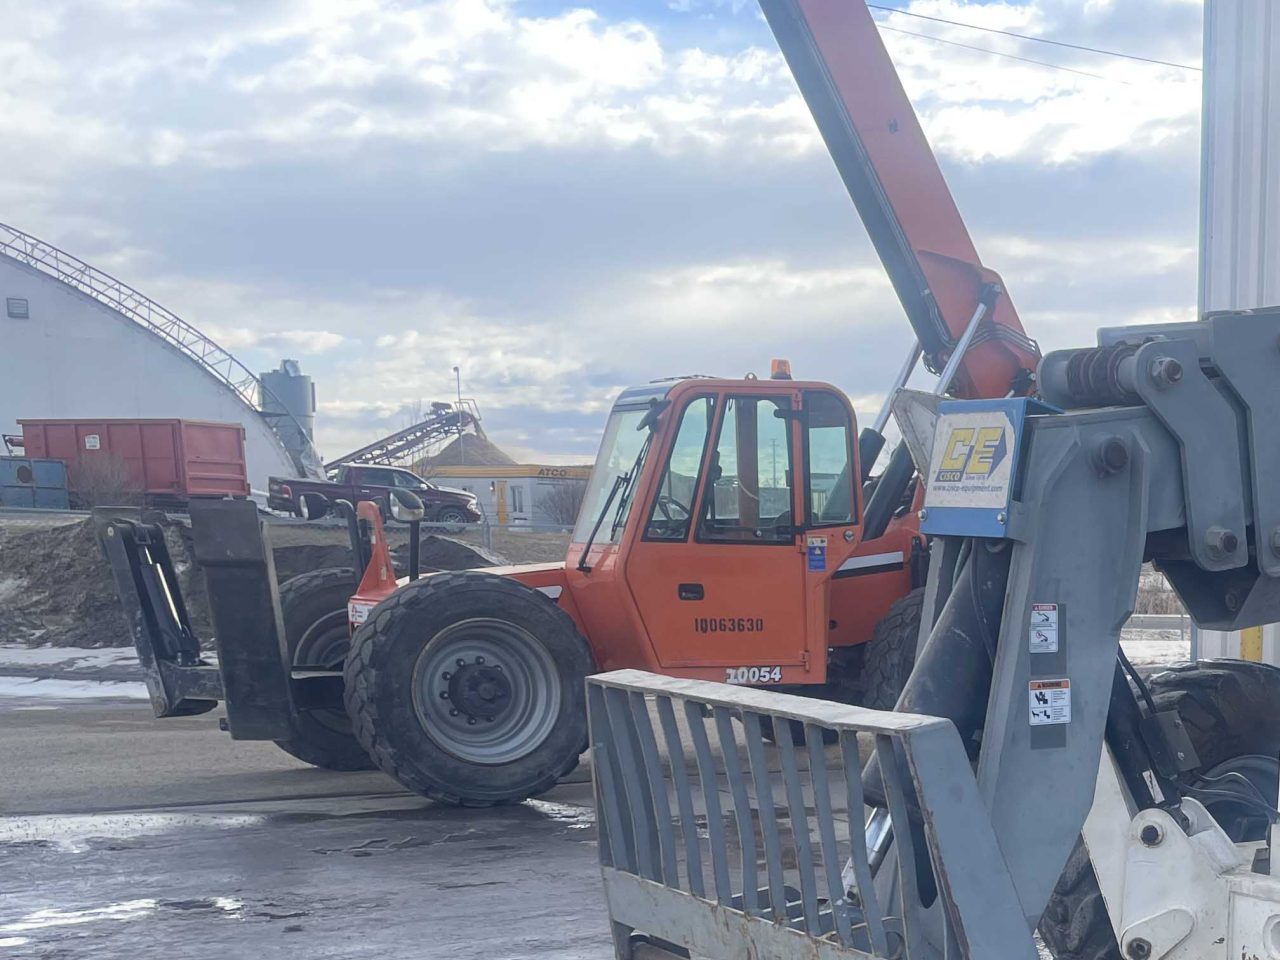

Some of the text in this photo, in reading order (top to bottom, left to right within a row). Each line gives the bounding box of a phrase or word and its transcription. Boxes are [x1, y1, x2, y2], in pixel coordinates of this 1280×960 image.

[940, 427, 1003, 474] CE
[538, 468, 567, 477] ATCO
[940, 471, 961, 481] CISCO
[726, 666, 782, 683] 10054
